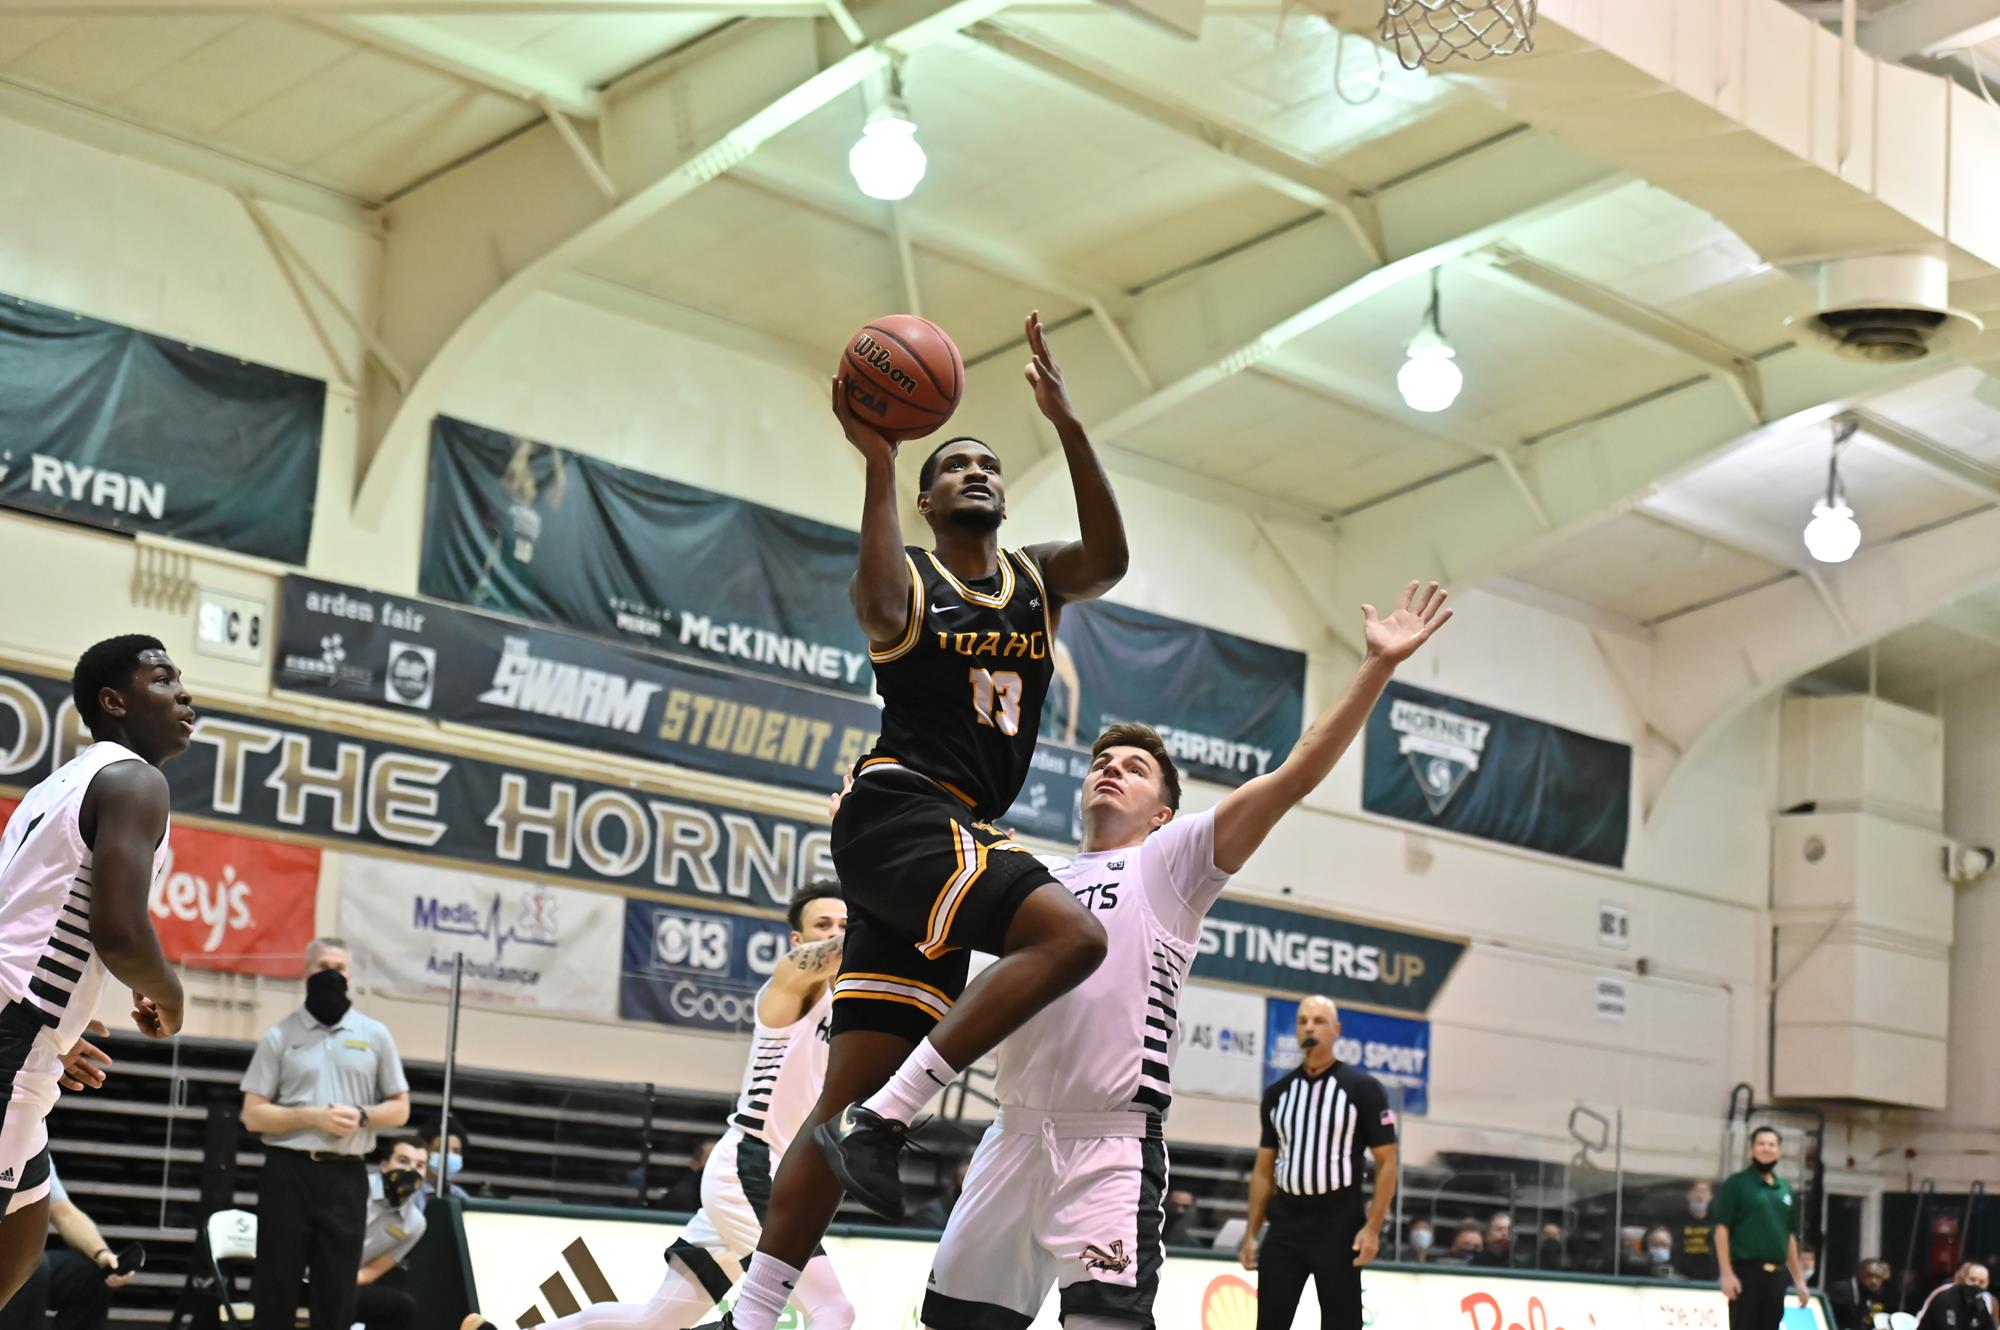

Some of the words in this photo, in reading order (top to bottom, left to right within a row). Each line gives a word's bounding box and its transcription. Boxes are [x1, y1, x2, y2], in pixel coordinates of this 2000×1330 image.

[853, 333, 917, 395] Wilson
[31, 453, 167, 520] RYAN
[306, 590, 375, 623] arden
[381, 601, 426, 633] fair
[680, 611, 866, 684] McKINNEY
[937, 631, 1046, 660] IDAHO
[478, 654, 664, 734] SWARM
[659, 689, 832, 771] STUDENT
[968, 666, 1023, 737] 13
[1397, 705, 1481, 747] HORNET
[190, 716, 453, 847] THE
[149, 845, 251, 953] ley's
[414, 895, 478, 931] Medic
